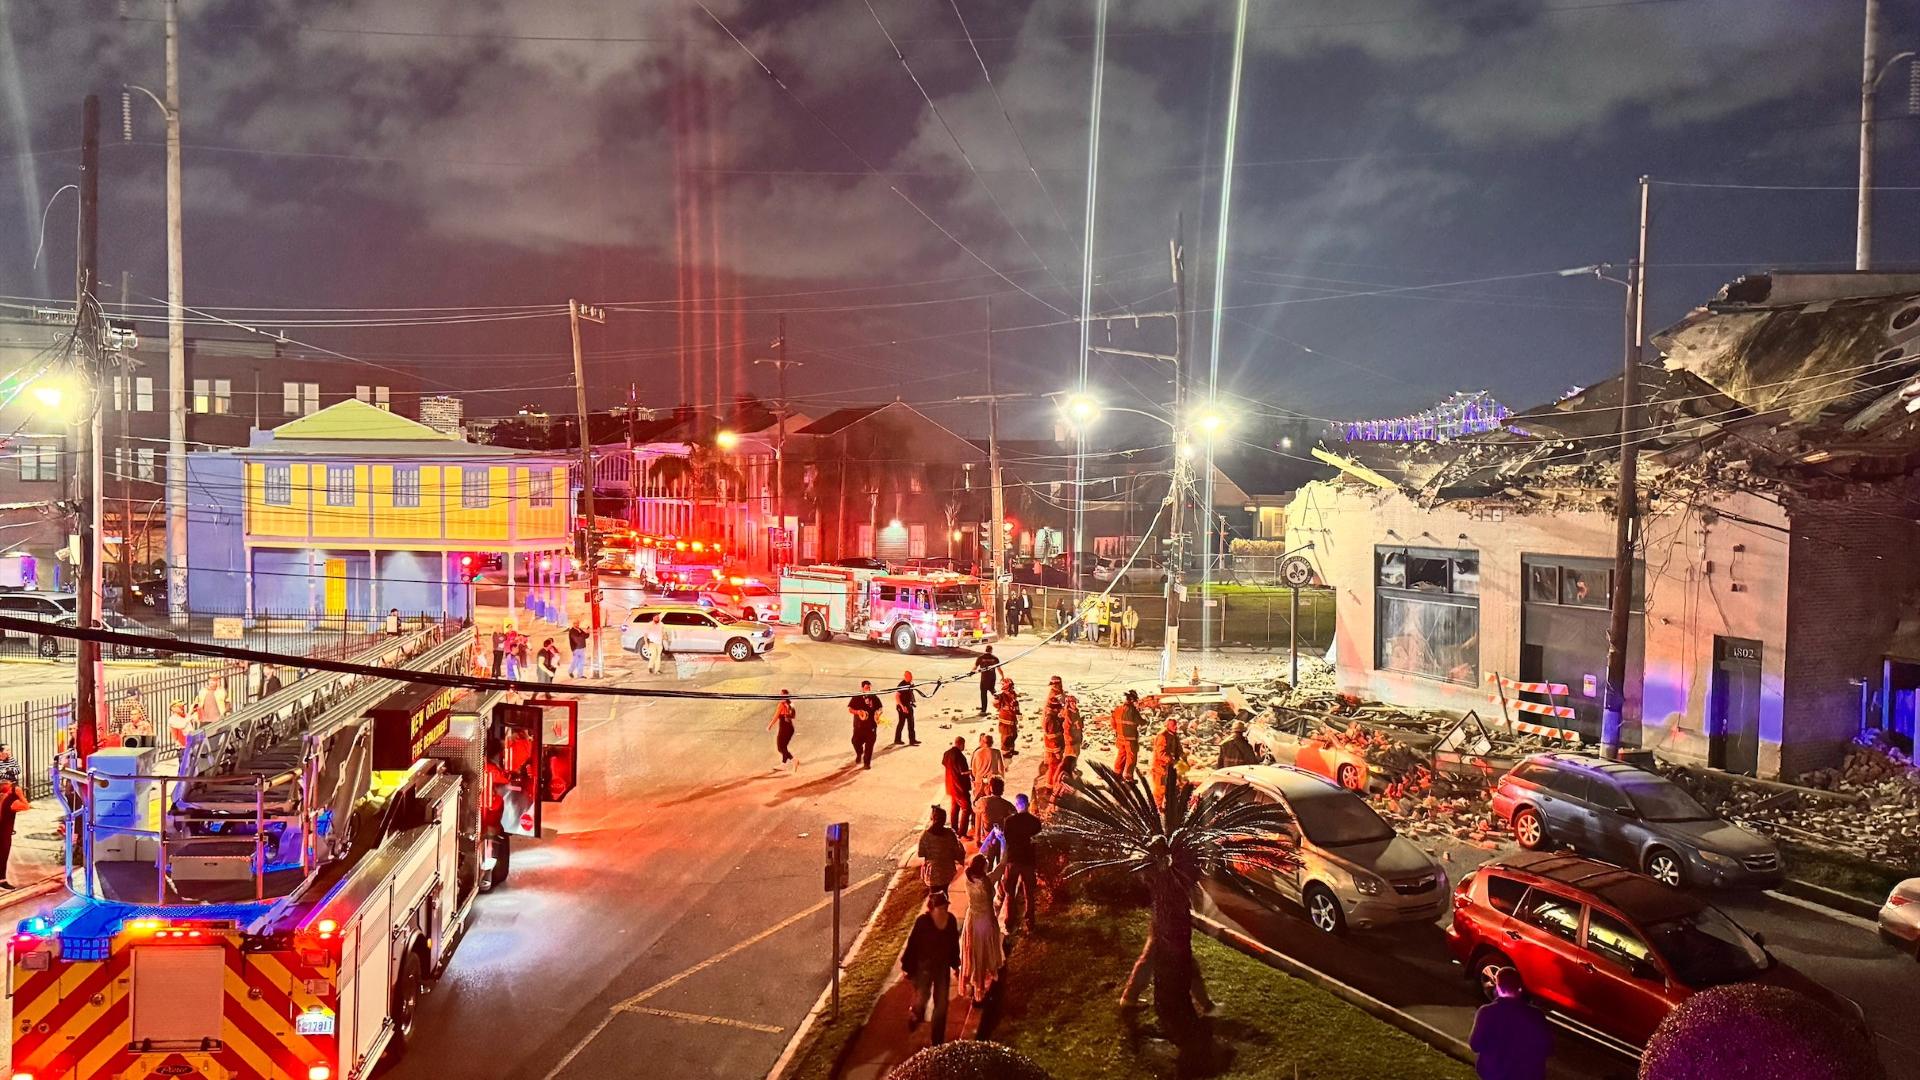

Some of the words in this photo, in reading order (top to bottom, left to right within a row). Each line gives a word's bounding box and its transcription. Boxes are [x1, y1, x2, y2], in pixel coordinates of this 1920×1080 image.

[1733, 647, 1754, 658] 1802
[411, 708, 425, 740] NEW
[426, 687, 452, 720] ORLEANS
[412, 738, 423, 761] FIRE
[424, 716, 448, 750] DEPARTMENT
